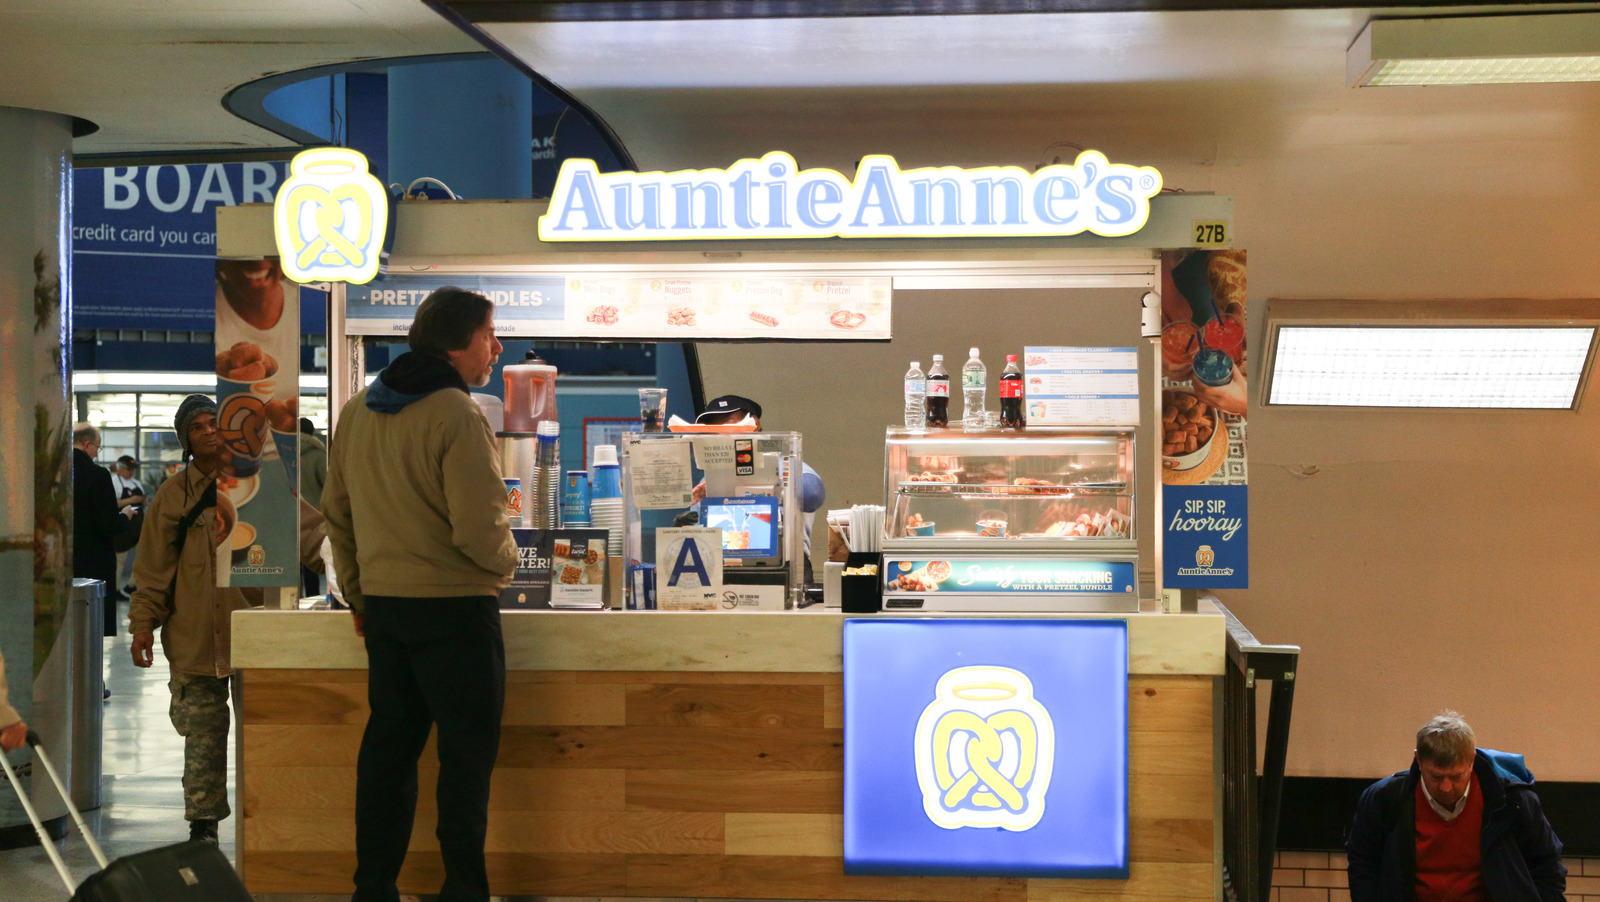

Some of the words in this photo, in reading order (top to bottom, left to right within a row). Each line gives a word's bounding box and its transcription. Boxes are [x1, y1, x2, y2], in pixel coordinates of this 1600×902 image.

[103, 162, 291, 213] BOAR
[72, 223, 116, 241] credit
[120, 225, 155, 243] card
[159, 230, 188, 248] you
[1196, 223, 1225, 243] 27B
[584, 285, 598, 293] Mini
[600, 285, 616, 295] Dogs
[664, 286, 692, 295] Nuggets
[745, 286, 768, 295] Pretzel
[771, 286, 784, 296] Dog
[827, 286, 851, 295] Pretzel
[370, 289, 437, 306] PRETZ
[473, 290, 543, 307] NDLES
[1185, 500, 1204, 515] SIP,
[1206, 500, 1226, 515] SIP,
[1168, 509, 1243, 541] hooray
[516, 558, 551, 569] TER!
[667, 538, 712, 586] A
[1020, 571, 1051, 583] YOUR
[1054, 571, 1113, 584] SNACKING
